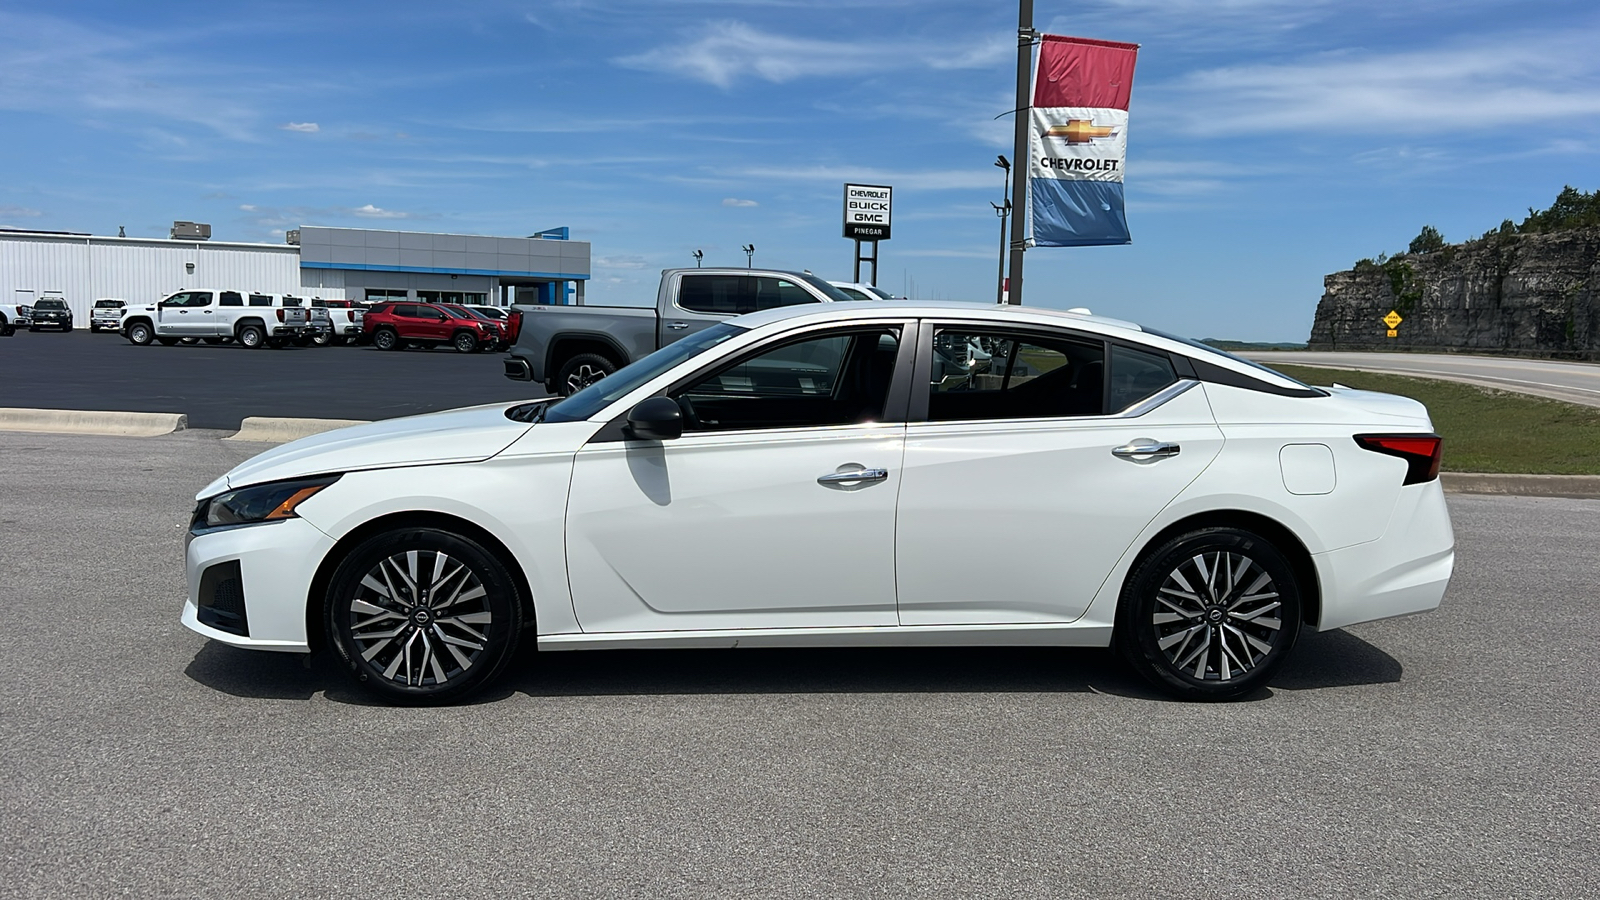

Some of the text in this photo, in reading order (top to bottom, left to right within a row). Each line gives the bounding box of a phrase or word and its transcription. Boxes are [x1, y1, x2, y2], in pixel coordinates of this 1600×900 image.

[851, 190, 888, 198] CHEVROLET
[850, 202, 888, 211] BUICK
[855, 213, 883, 222] GMC
